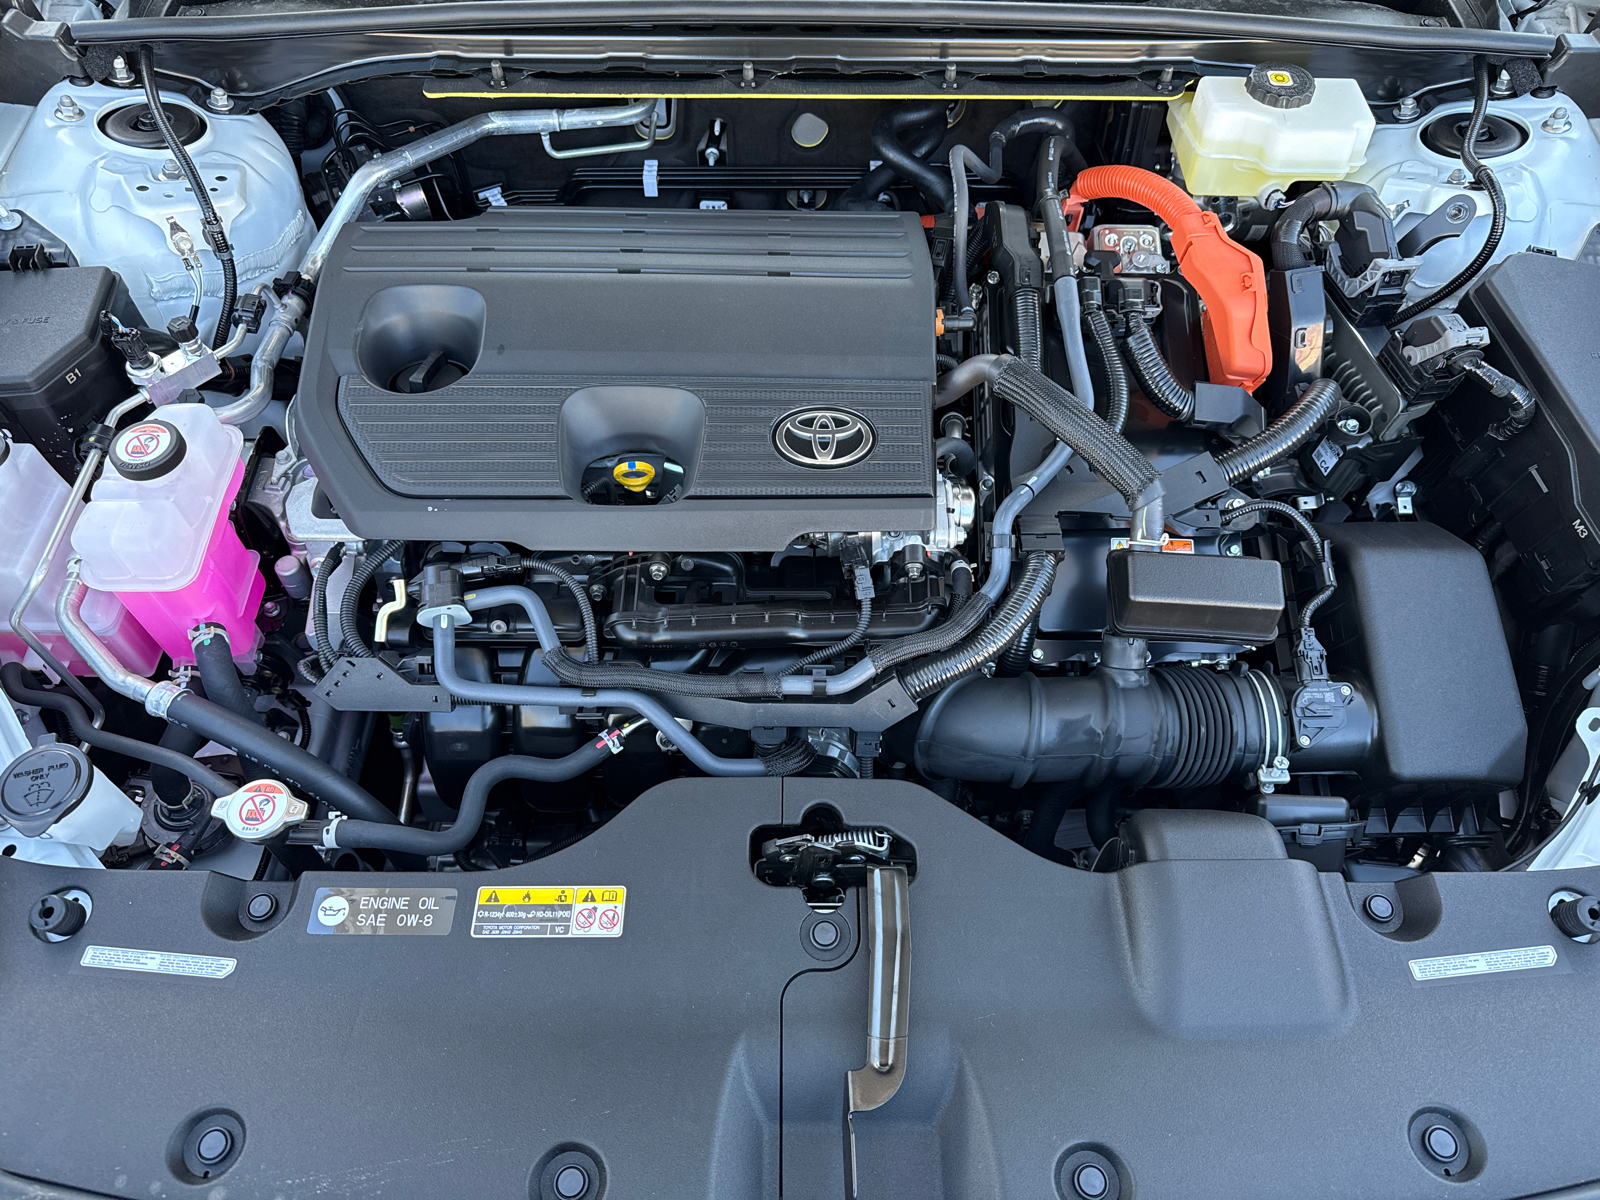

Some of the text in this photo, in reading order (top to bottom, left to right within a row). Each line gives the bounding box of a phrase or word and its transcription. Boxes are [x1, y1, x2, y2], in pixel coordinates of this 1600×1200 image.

[20, 316, 50, 325] FUSE
[65, 368, 82, 385] B1
[1320, 459, 1330, 473] C4
[1572, 519, 1588, 538] M3
[12, 762, 69, 779] WASHER FLUID
[30, 773, 50, 782] ONLY
[359, 896, 440, 910] ENGINE OIL
[356, 913, 434, 927] SAE 0W-8
[554, 926, 565, 934] VC
